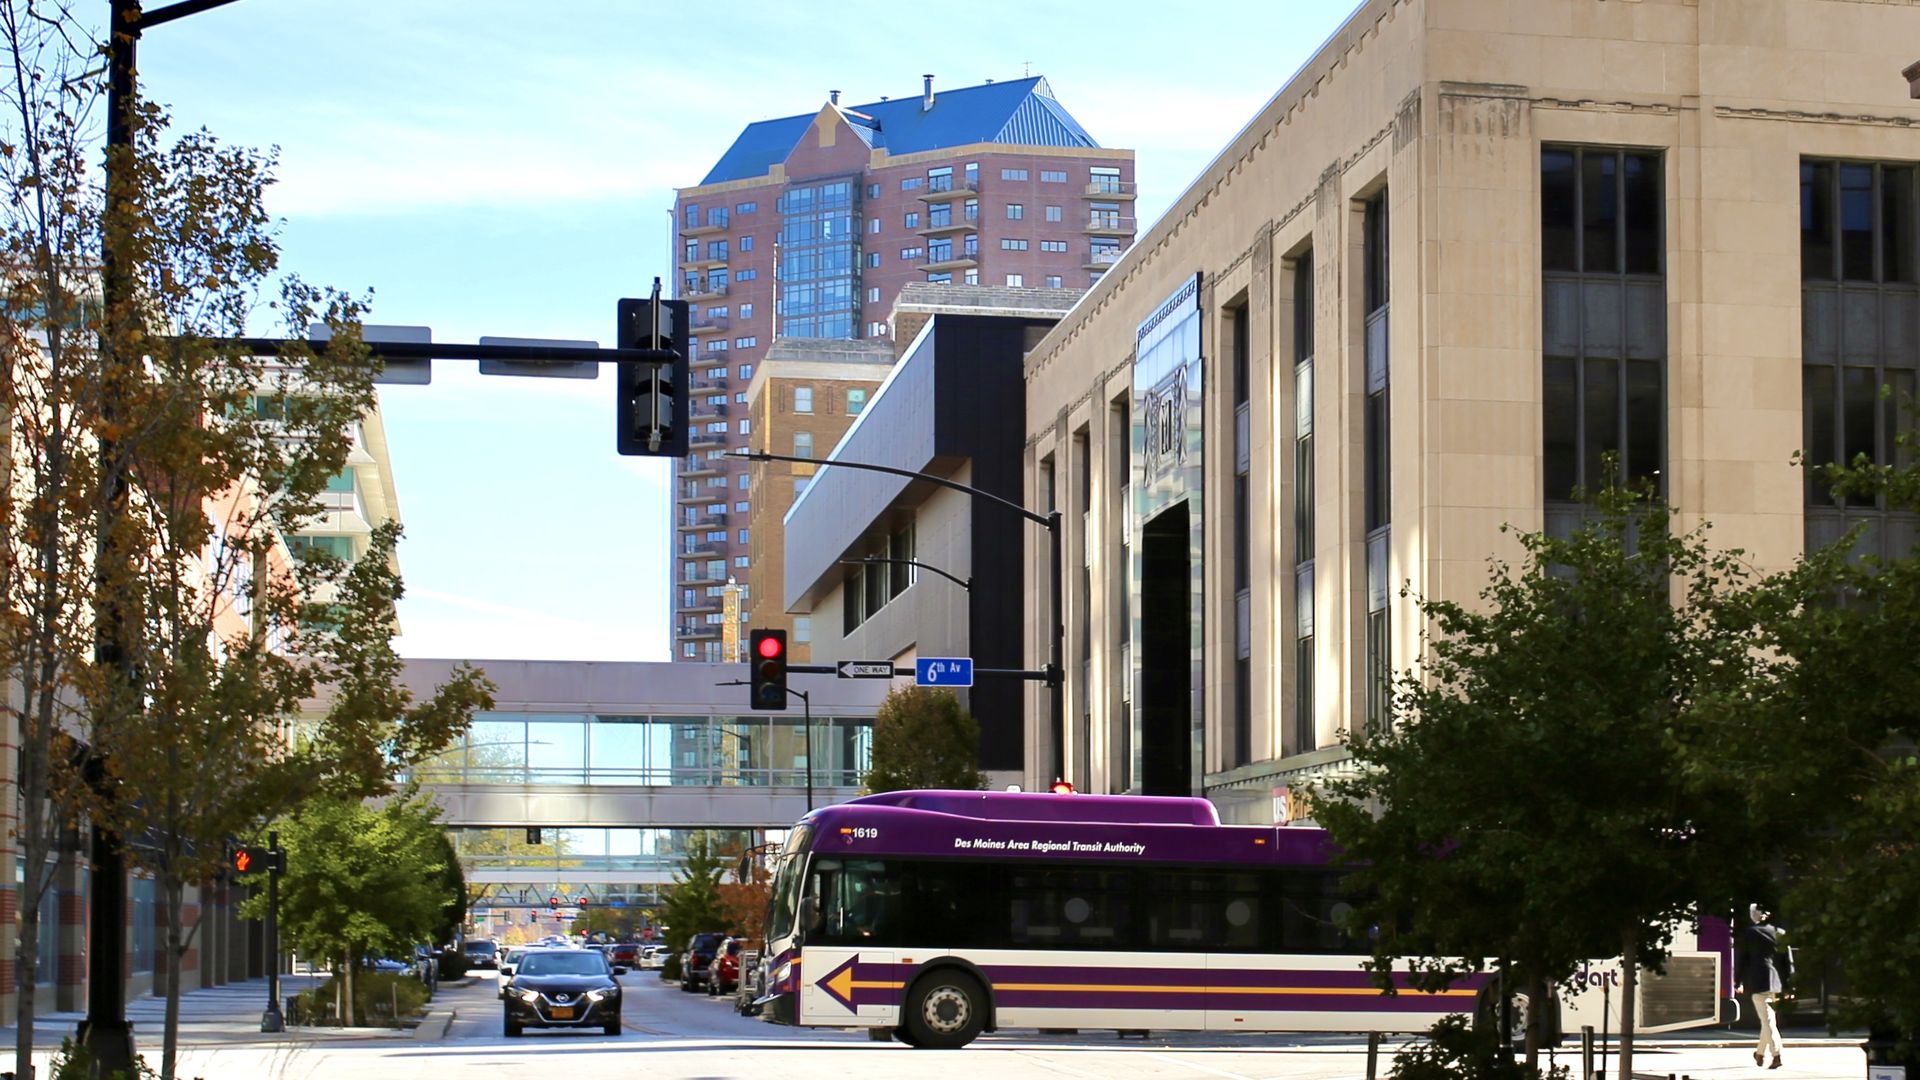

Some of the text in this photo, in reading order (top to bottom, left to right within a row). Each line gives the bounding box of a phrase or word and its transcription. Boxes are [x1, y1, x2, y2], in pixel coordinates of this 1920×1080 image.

[854, 665, 888, 674] ONE WAY
[927, 661, 961, 682] 6th Av
[852, 827, 878, 838] 1619
[954, 838, 1146, 856] Des Moines Area Regional Transit Authority
[1574, 961, 1618, 987] dart
